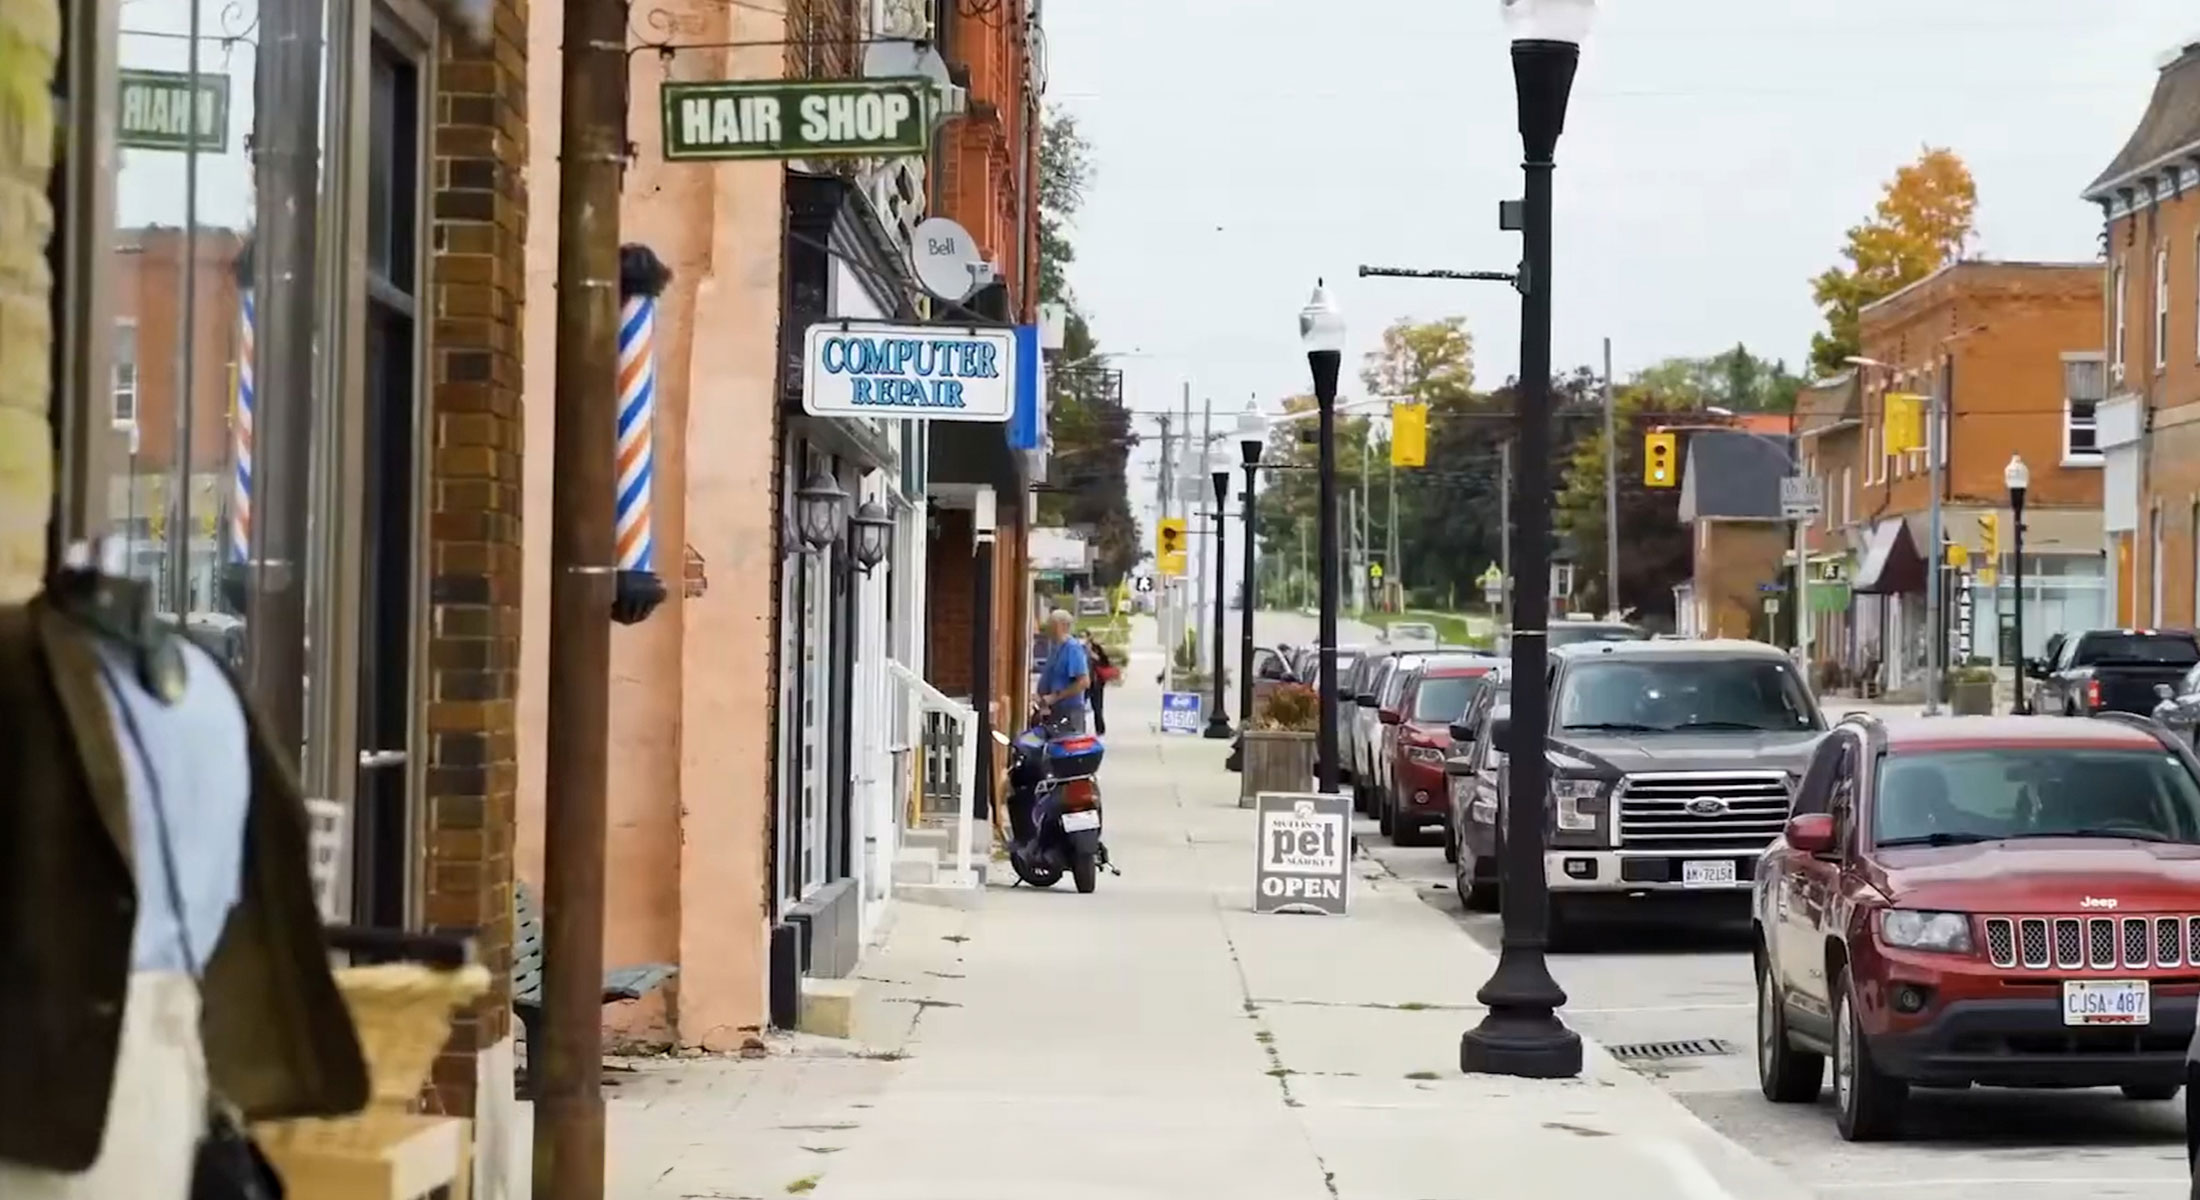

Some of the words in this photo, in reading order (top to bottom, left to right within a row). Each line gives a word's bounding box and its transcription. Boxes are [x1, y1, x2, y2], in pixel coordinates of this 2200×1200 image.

[682, 97, 781, 144] HAIR
[800, 93, 910, 142] SHOP
[928, 237, 955, 256] Bell
[822, 336, 999, 378] COMPUTER
[850, 377, 966, 408] REPAIR
[1272, 823, 1335, 864] pet
[1262, 877, 1341, 899] OPEN
[2080, 896, 2117, 909] Jeep
